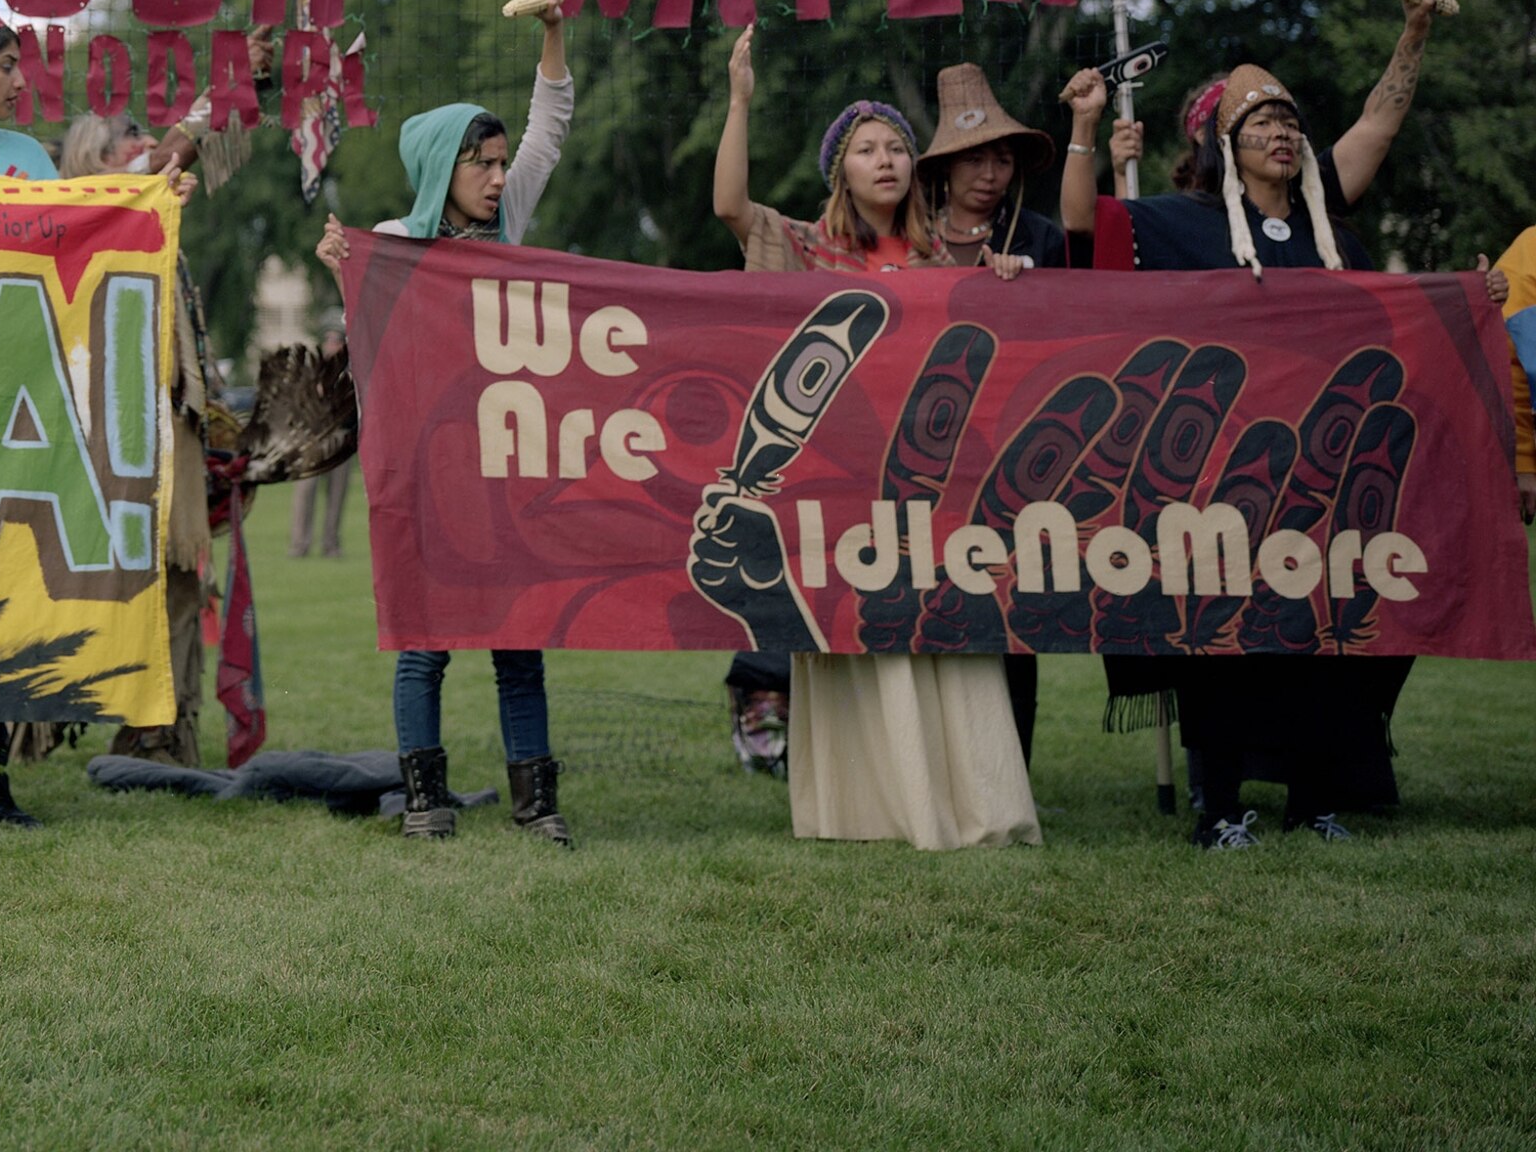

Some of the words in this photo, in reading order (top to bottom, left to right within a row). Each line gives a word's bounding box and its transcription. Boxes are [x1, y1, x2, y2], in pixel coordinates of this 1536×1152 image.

[472, 278, 649, 377] We
[477, 380, 668, 482] Are
[796, 499, 1429, 602] IdleNoMore
